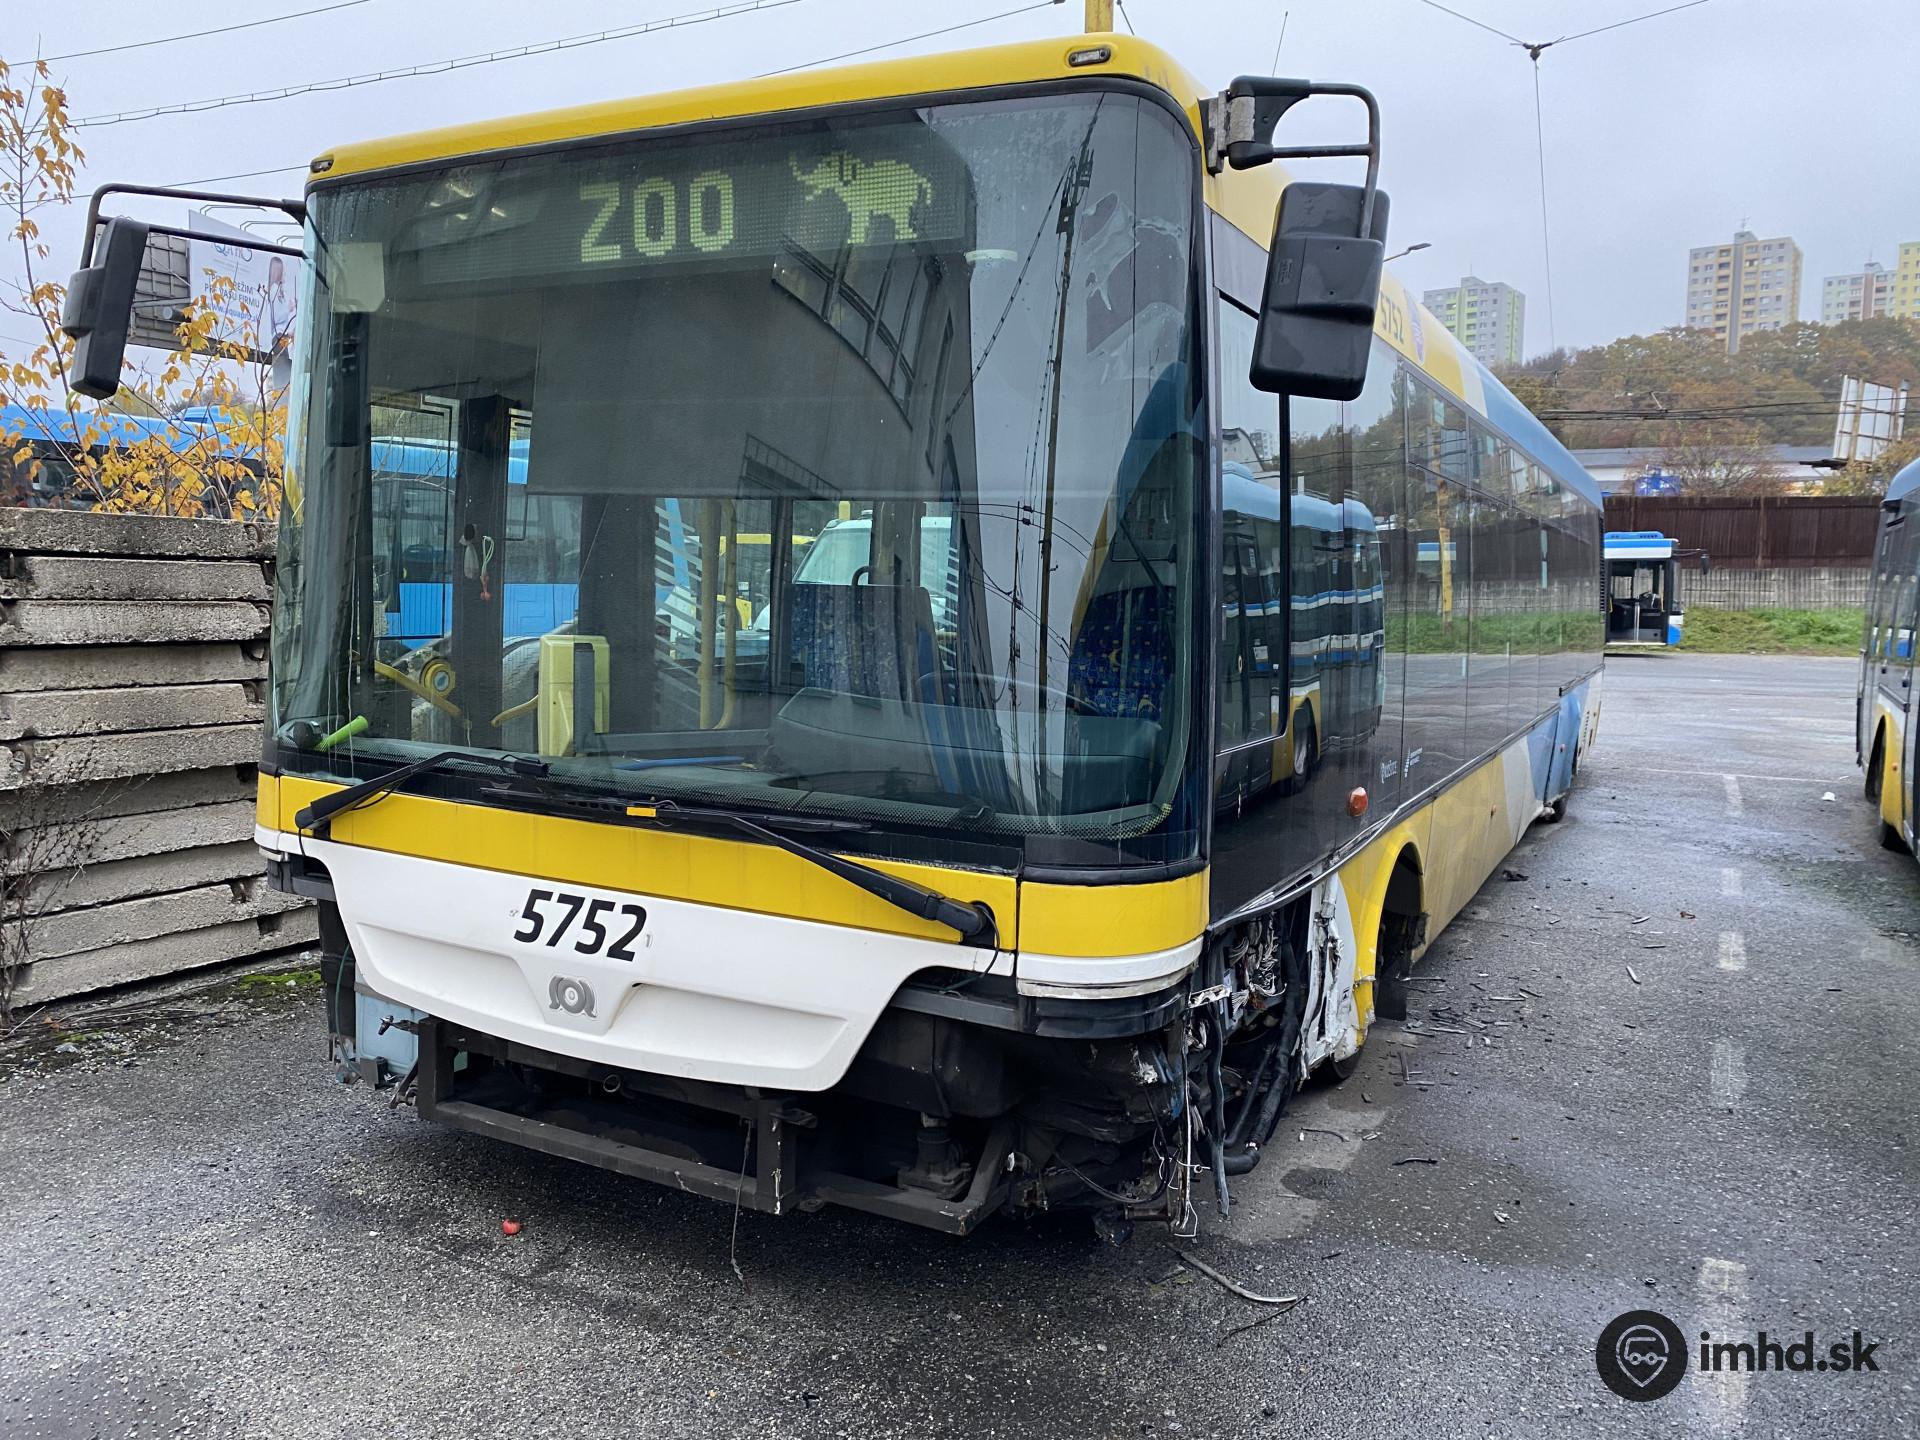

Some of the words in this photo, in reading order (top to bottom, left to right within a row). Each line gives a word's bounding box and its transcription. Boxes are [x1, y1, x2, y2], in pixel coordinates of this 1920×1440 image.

[580, 170, 733, 262] ZOO
[1380, 289, 1405, 345] 5752
[513, 888, 647, 962] 5752
